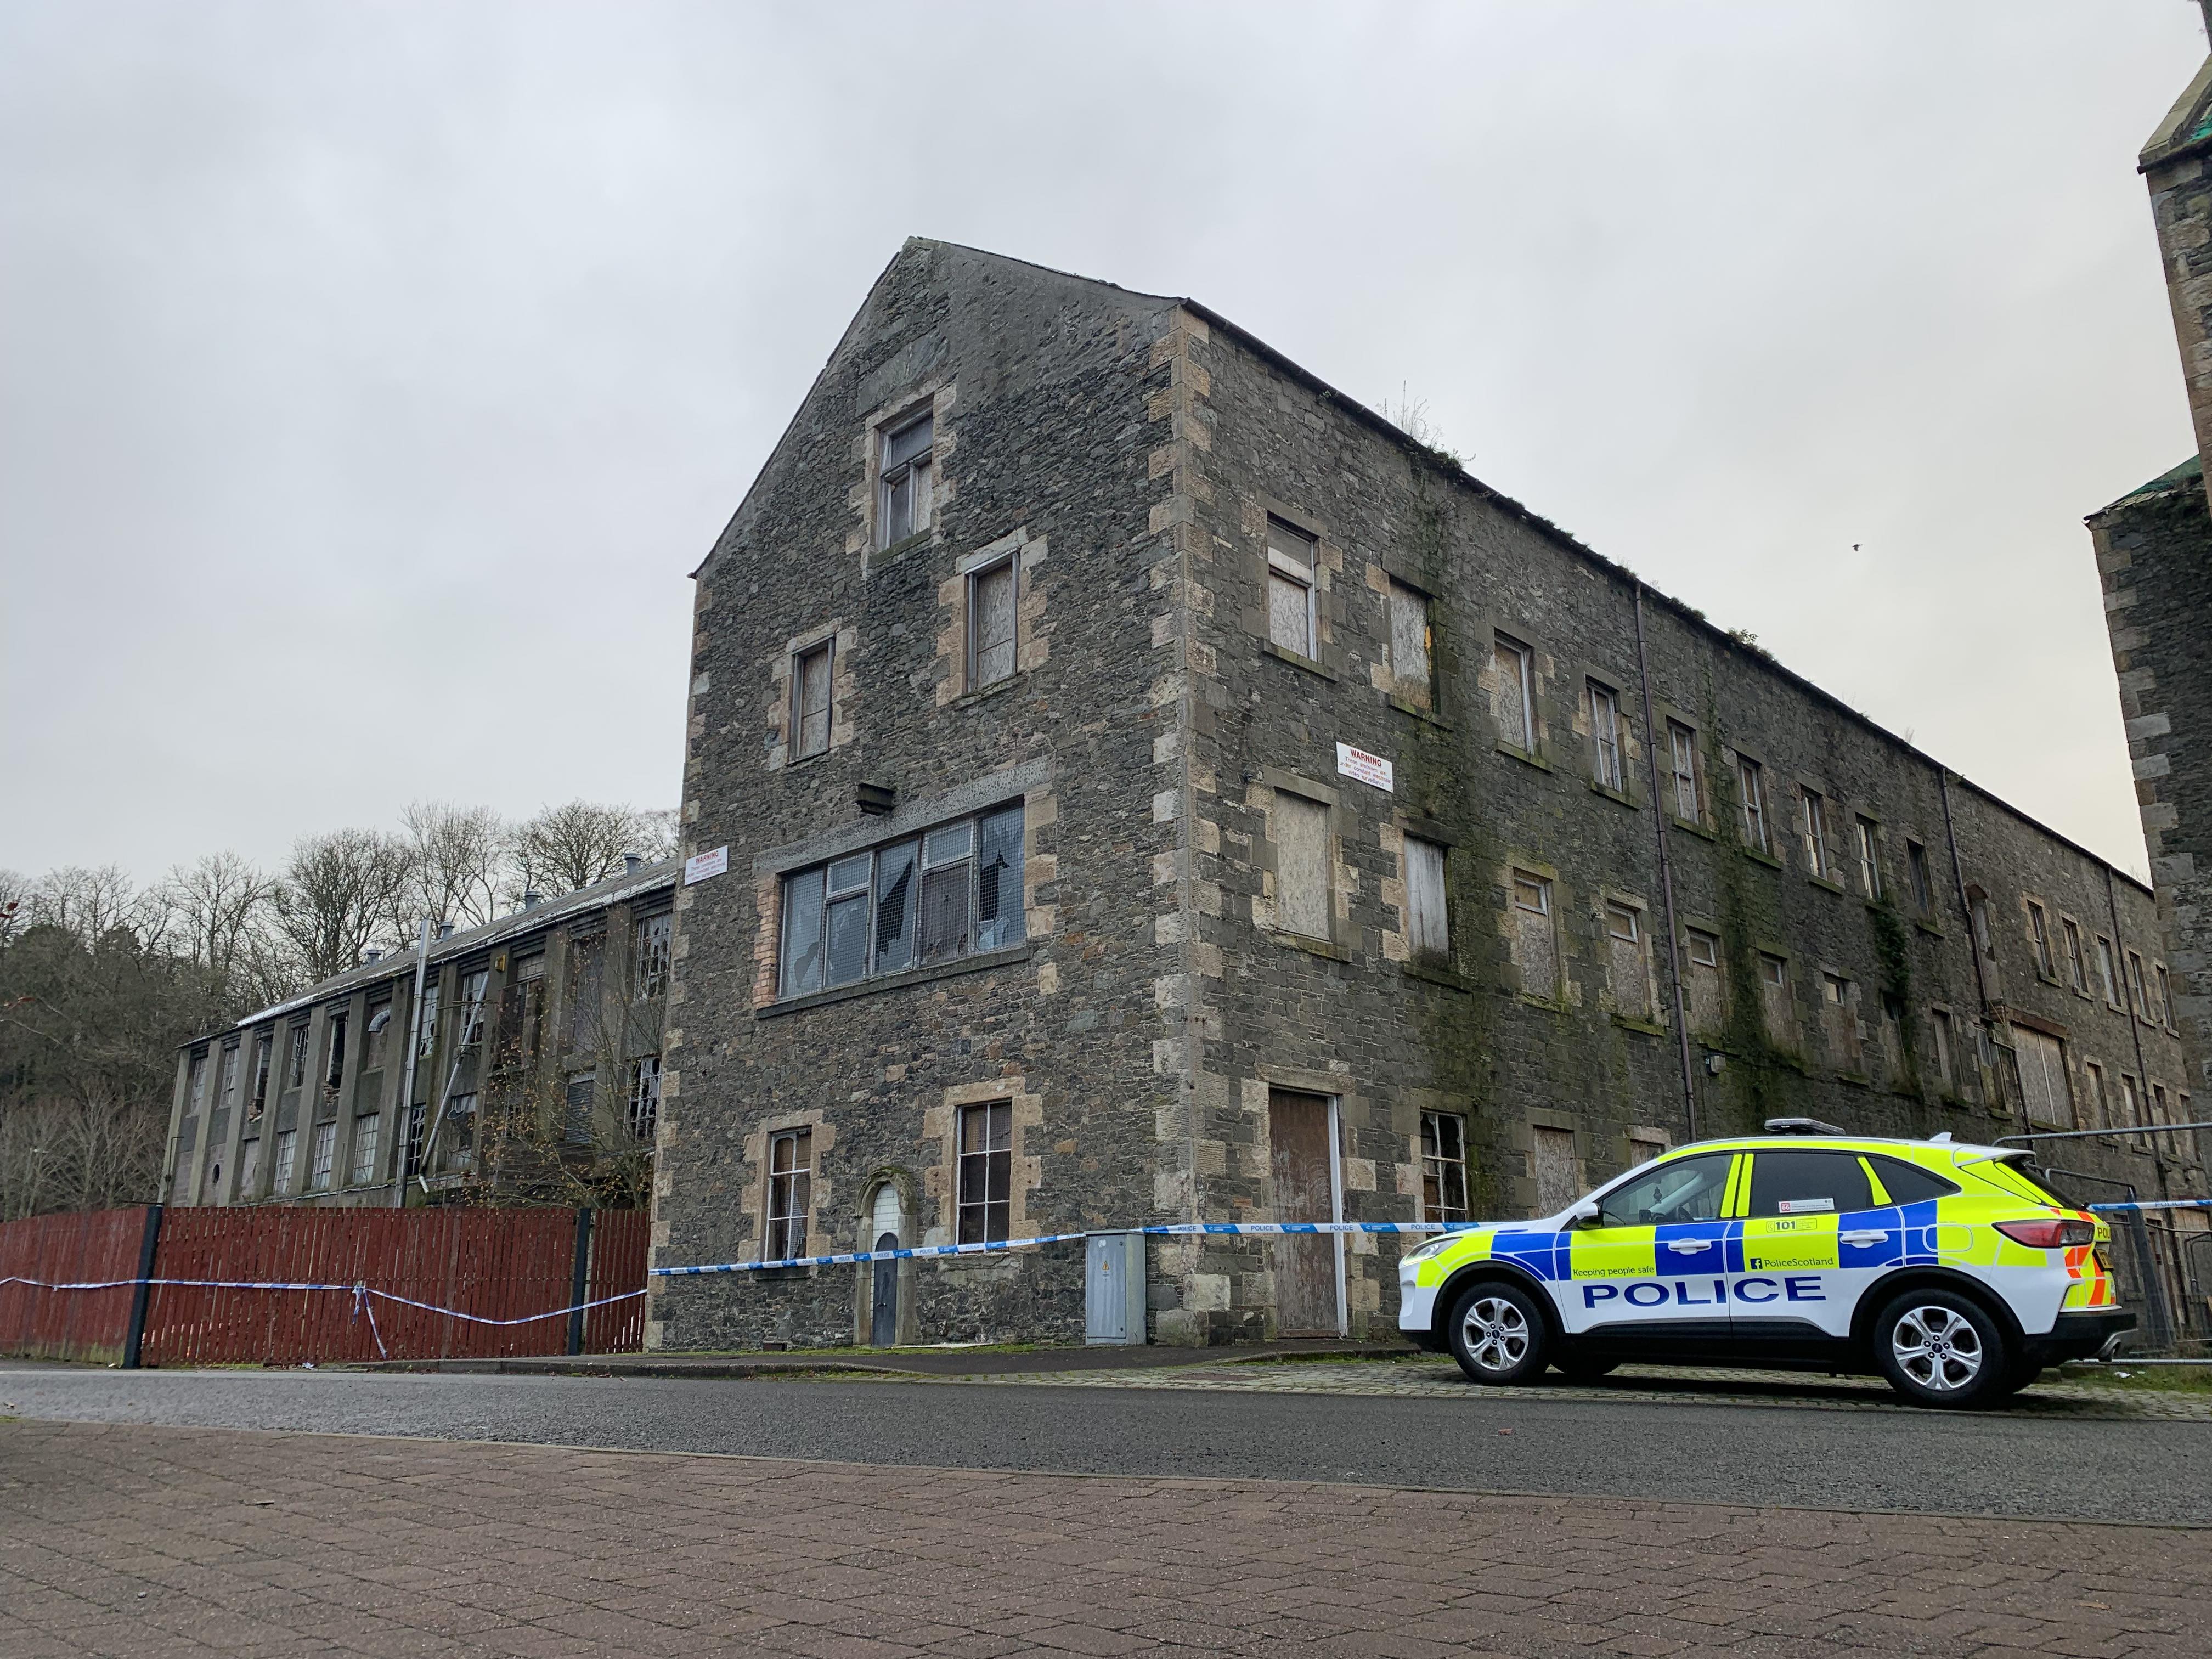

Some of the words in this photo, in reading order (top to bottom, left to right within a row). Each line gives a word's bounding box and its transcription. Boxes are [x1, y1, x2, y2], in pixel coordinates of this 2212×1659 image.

[1350, 748, 1381, 767] WARNING
[695, 850, 719, 863] WARNING
[1776, 1221, 1796, 1230] 101
[1764, 1257, 1834, 1267] PoliceScotland
[1573, 1268, 1605, 1277] Keeping
[1608, 1266, 1635, 1276] people
[1583, 1276, 1826, 1308] POLICE
